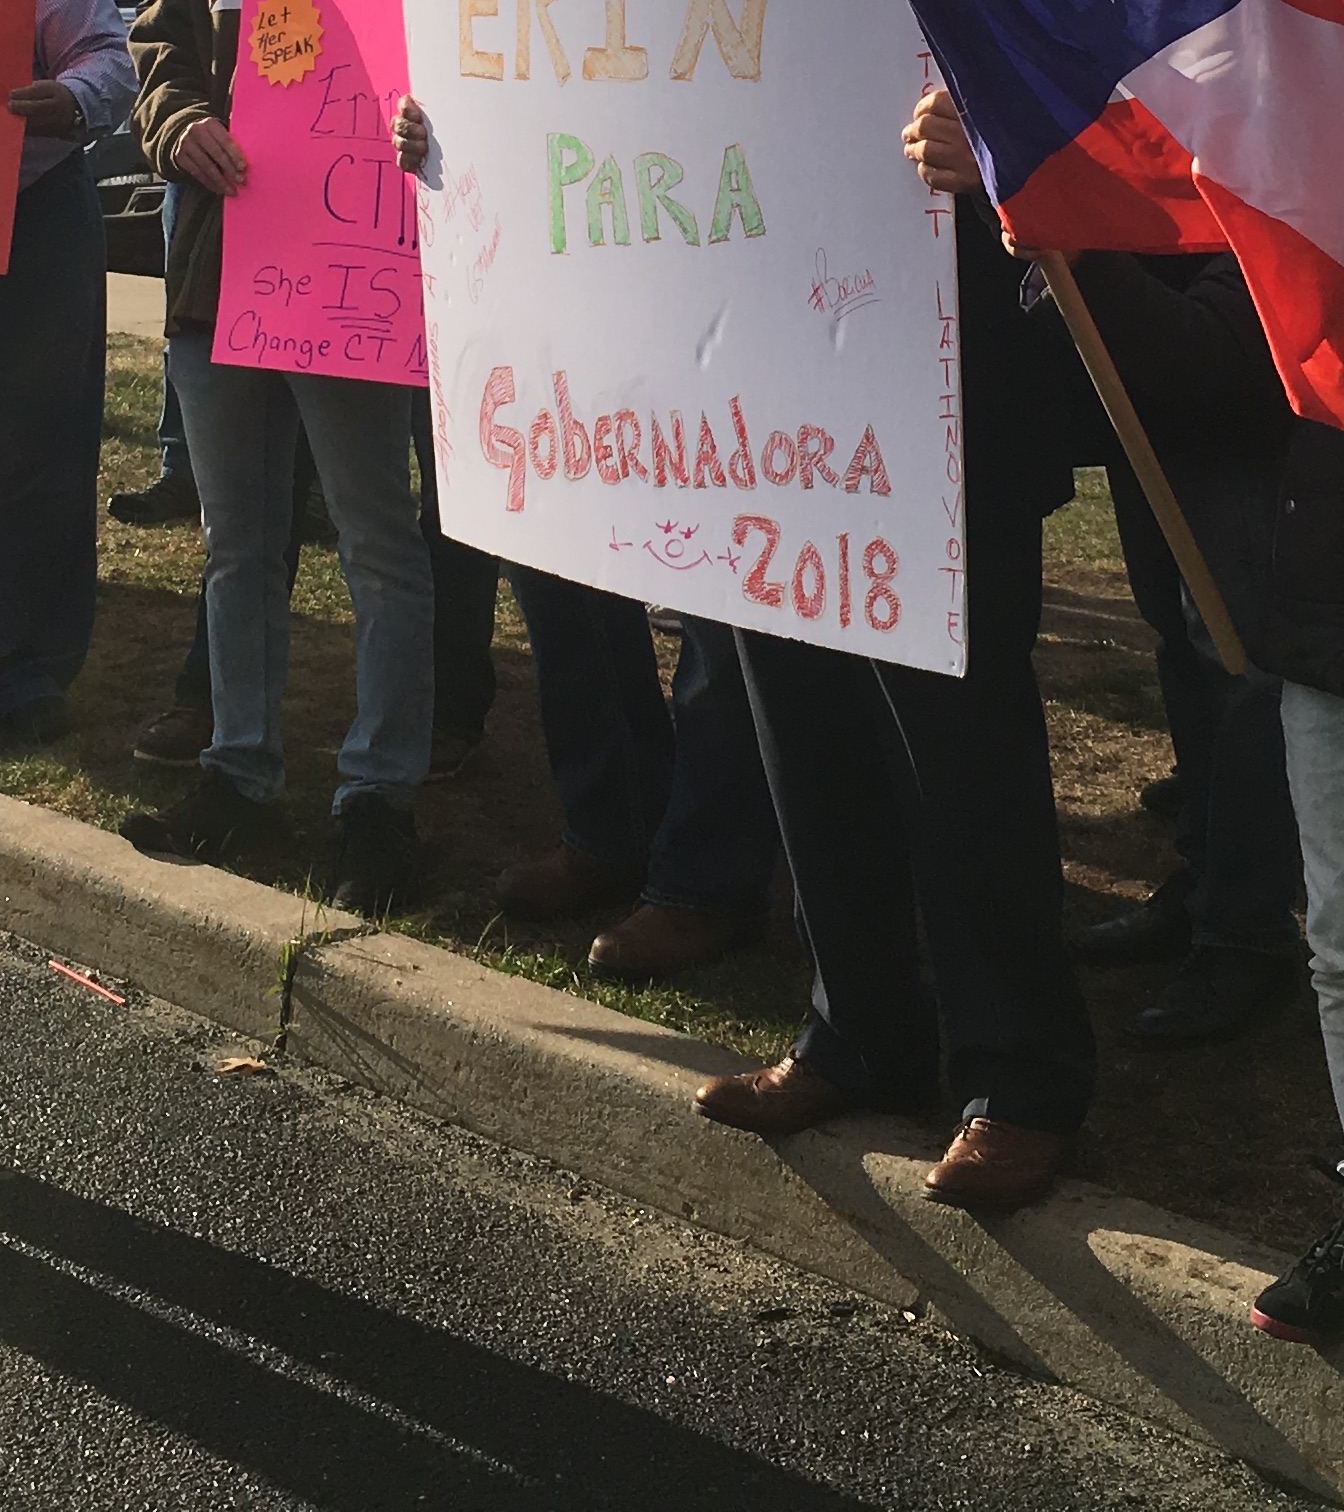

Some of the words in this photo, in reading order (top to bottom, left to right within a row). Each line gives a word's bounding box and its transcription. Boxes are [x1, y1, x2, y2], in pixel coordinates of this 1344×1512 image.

[257, 6, 292, 31] Let
[257, 31, 287, 54] Her
[262, 34, 314, 69] SPEAK
[546, 132, 767, 256] PARA
[253, 266, 312, 307] She
[323, 264, 402, 320] IS
[227, 310, 331, 370] Change
[344, 334, 399, 364] CT
[731, 513, 903, 635] 2018
[937, 490, 965, 648] VOTE
